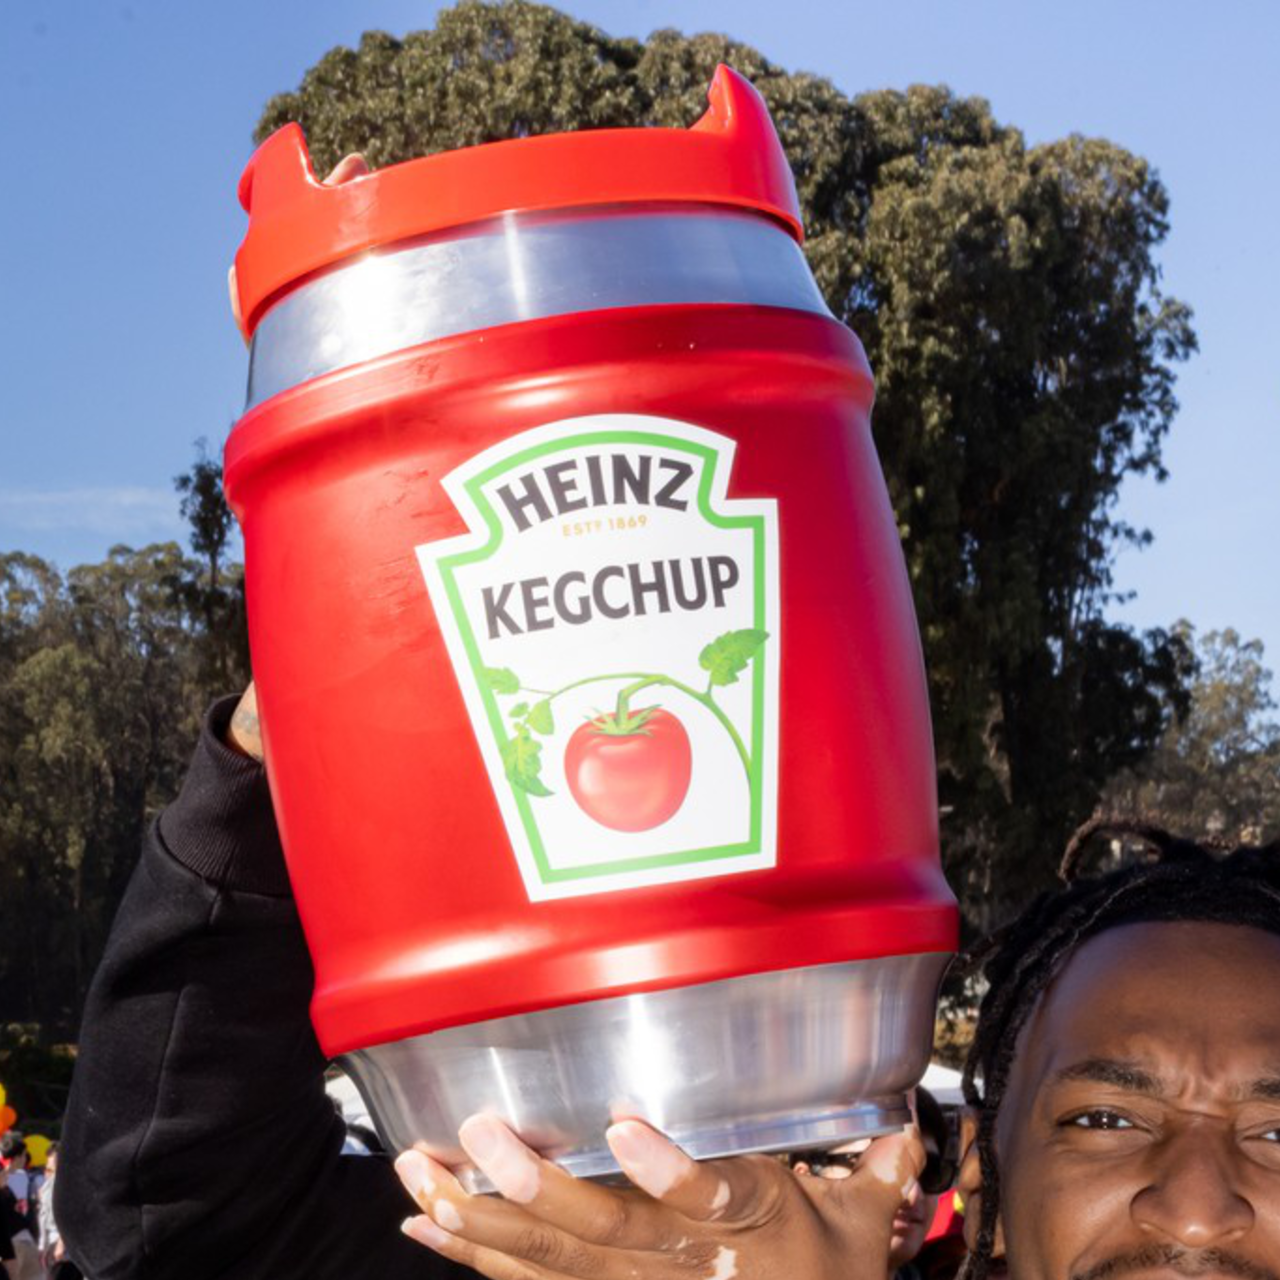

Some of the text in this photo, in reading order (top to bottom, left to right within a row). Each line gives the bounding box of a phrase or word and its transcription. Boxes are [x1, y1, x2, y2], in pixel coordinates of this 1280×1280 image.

[496, 453, 694, 533] HEINZ
[607, 513, 648, 531] 1869
[481, 555, 740, 640] KEGCHUP
